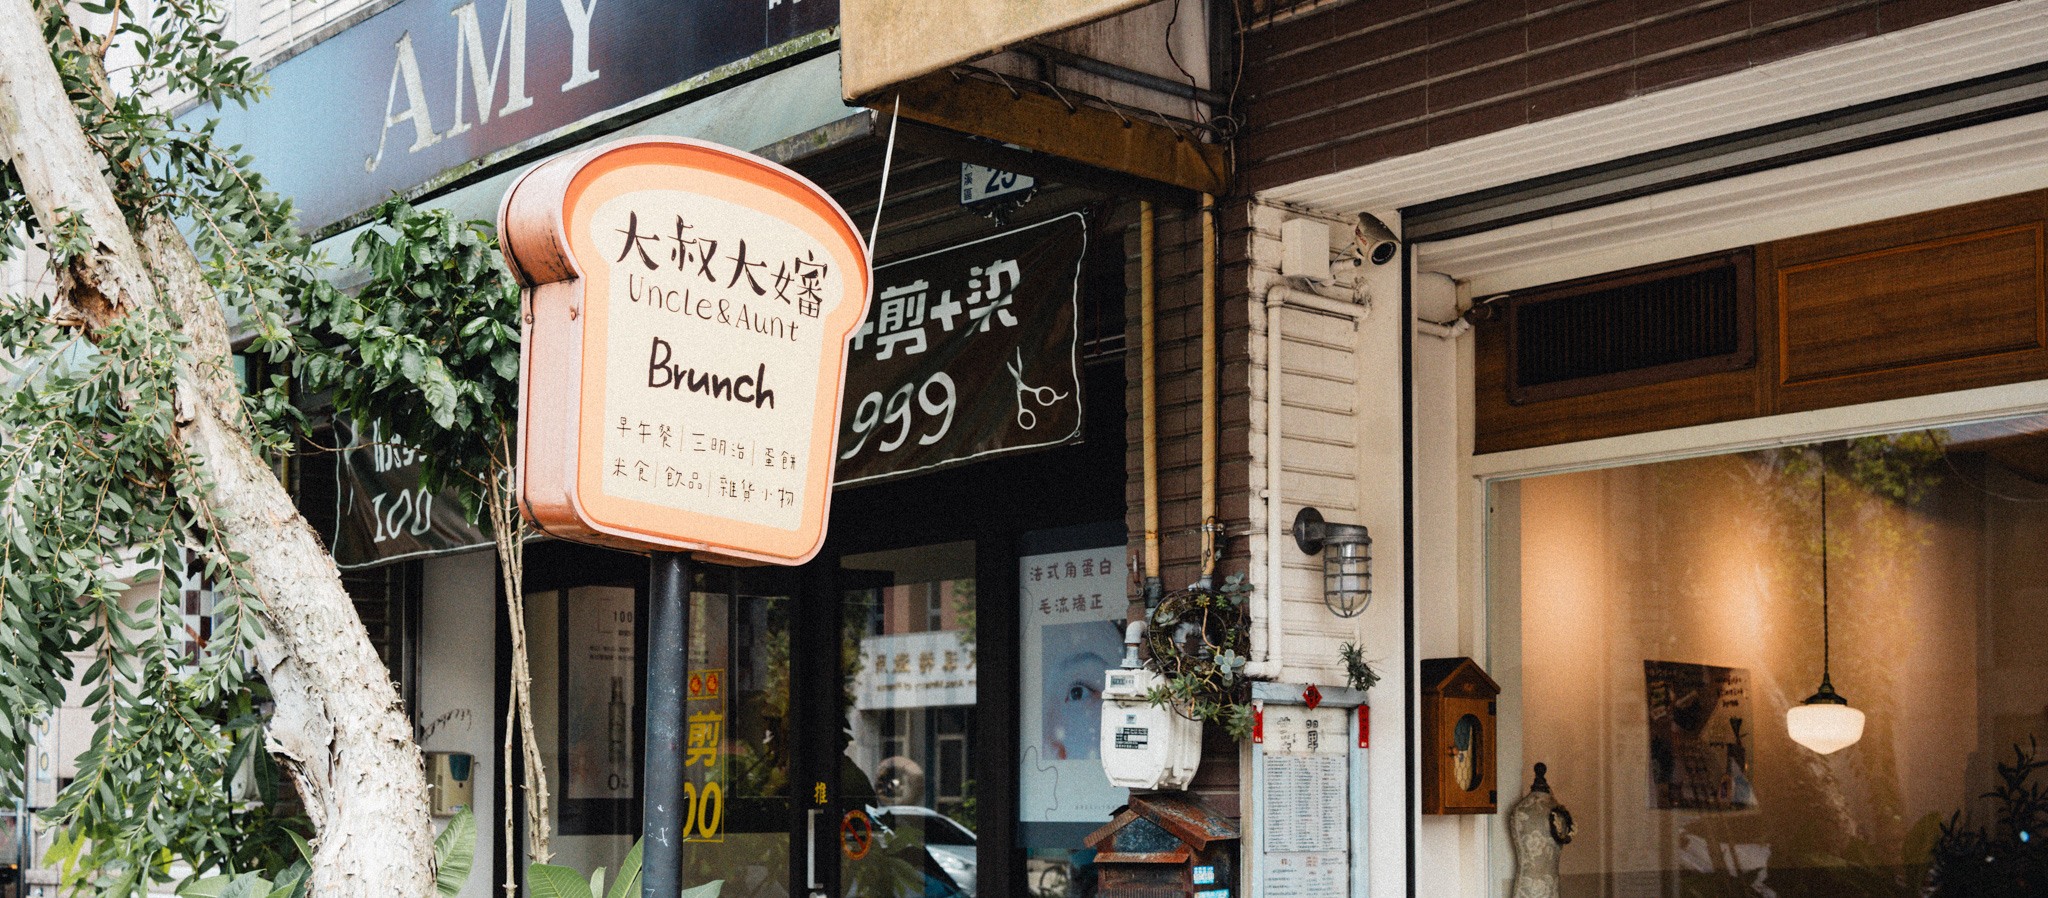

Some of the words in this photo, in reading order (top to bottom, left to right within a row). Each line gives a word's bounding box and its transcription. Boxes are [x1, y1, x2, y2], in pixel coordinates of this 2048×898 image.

[364, 0, 600, 175] AMY
[615, 210, 828, 319] 大叔大嬸
[629, 273, 799, 342] Uncle&Aunt
[648, 336, 775, 410] Brunch
[616, 416, 672, 448] 早午餐
[691, 431, 745, 460] 三明治
[764, 447, 797, 471] 蛋餅
[840, 371, 957, 460] 999
[612, 457, 650, 482] 米食
[665, 466, 703, 490] 飲品
[718, 474, 794, 508] 雜貨小物
[1029, 557, 1111, 582] 法式角蛋白
[1039, 594, 1104, 615] 毛流矯正
[685, 710, 723, 768] 剪
[813, 781, 828, 805] 推
